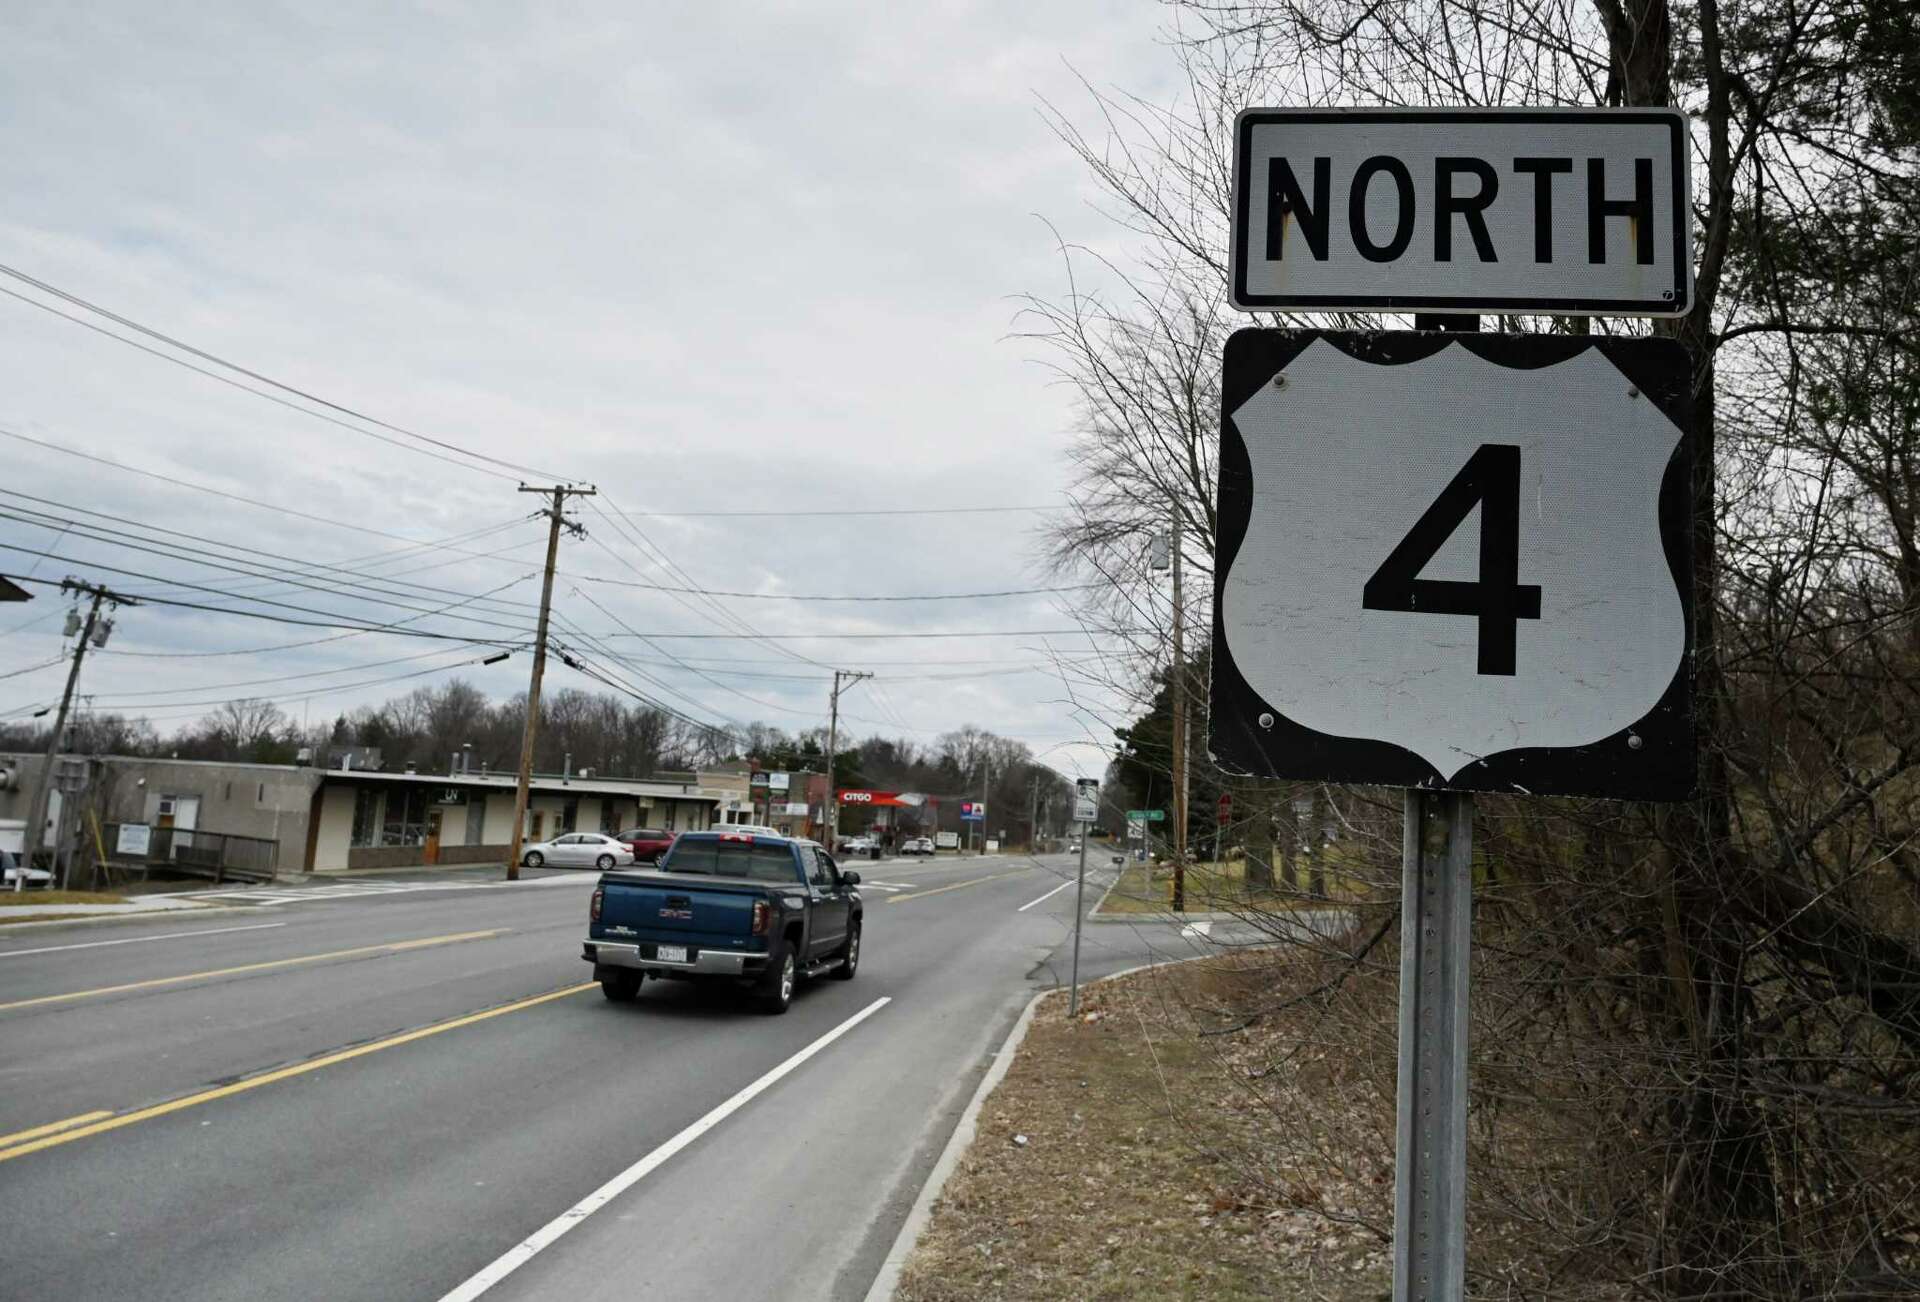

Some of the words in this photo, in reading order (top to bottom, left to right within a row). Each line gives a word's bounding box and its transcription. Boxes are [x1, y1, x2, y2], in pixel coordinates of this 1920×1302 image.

[1265, 154, 1655, 266] NORTH
[1362, 443, 1542, 677] 4
[843, 792, 872, 802] CITGO
[658, 908, 693, 920] GMC
